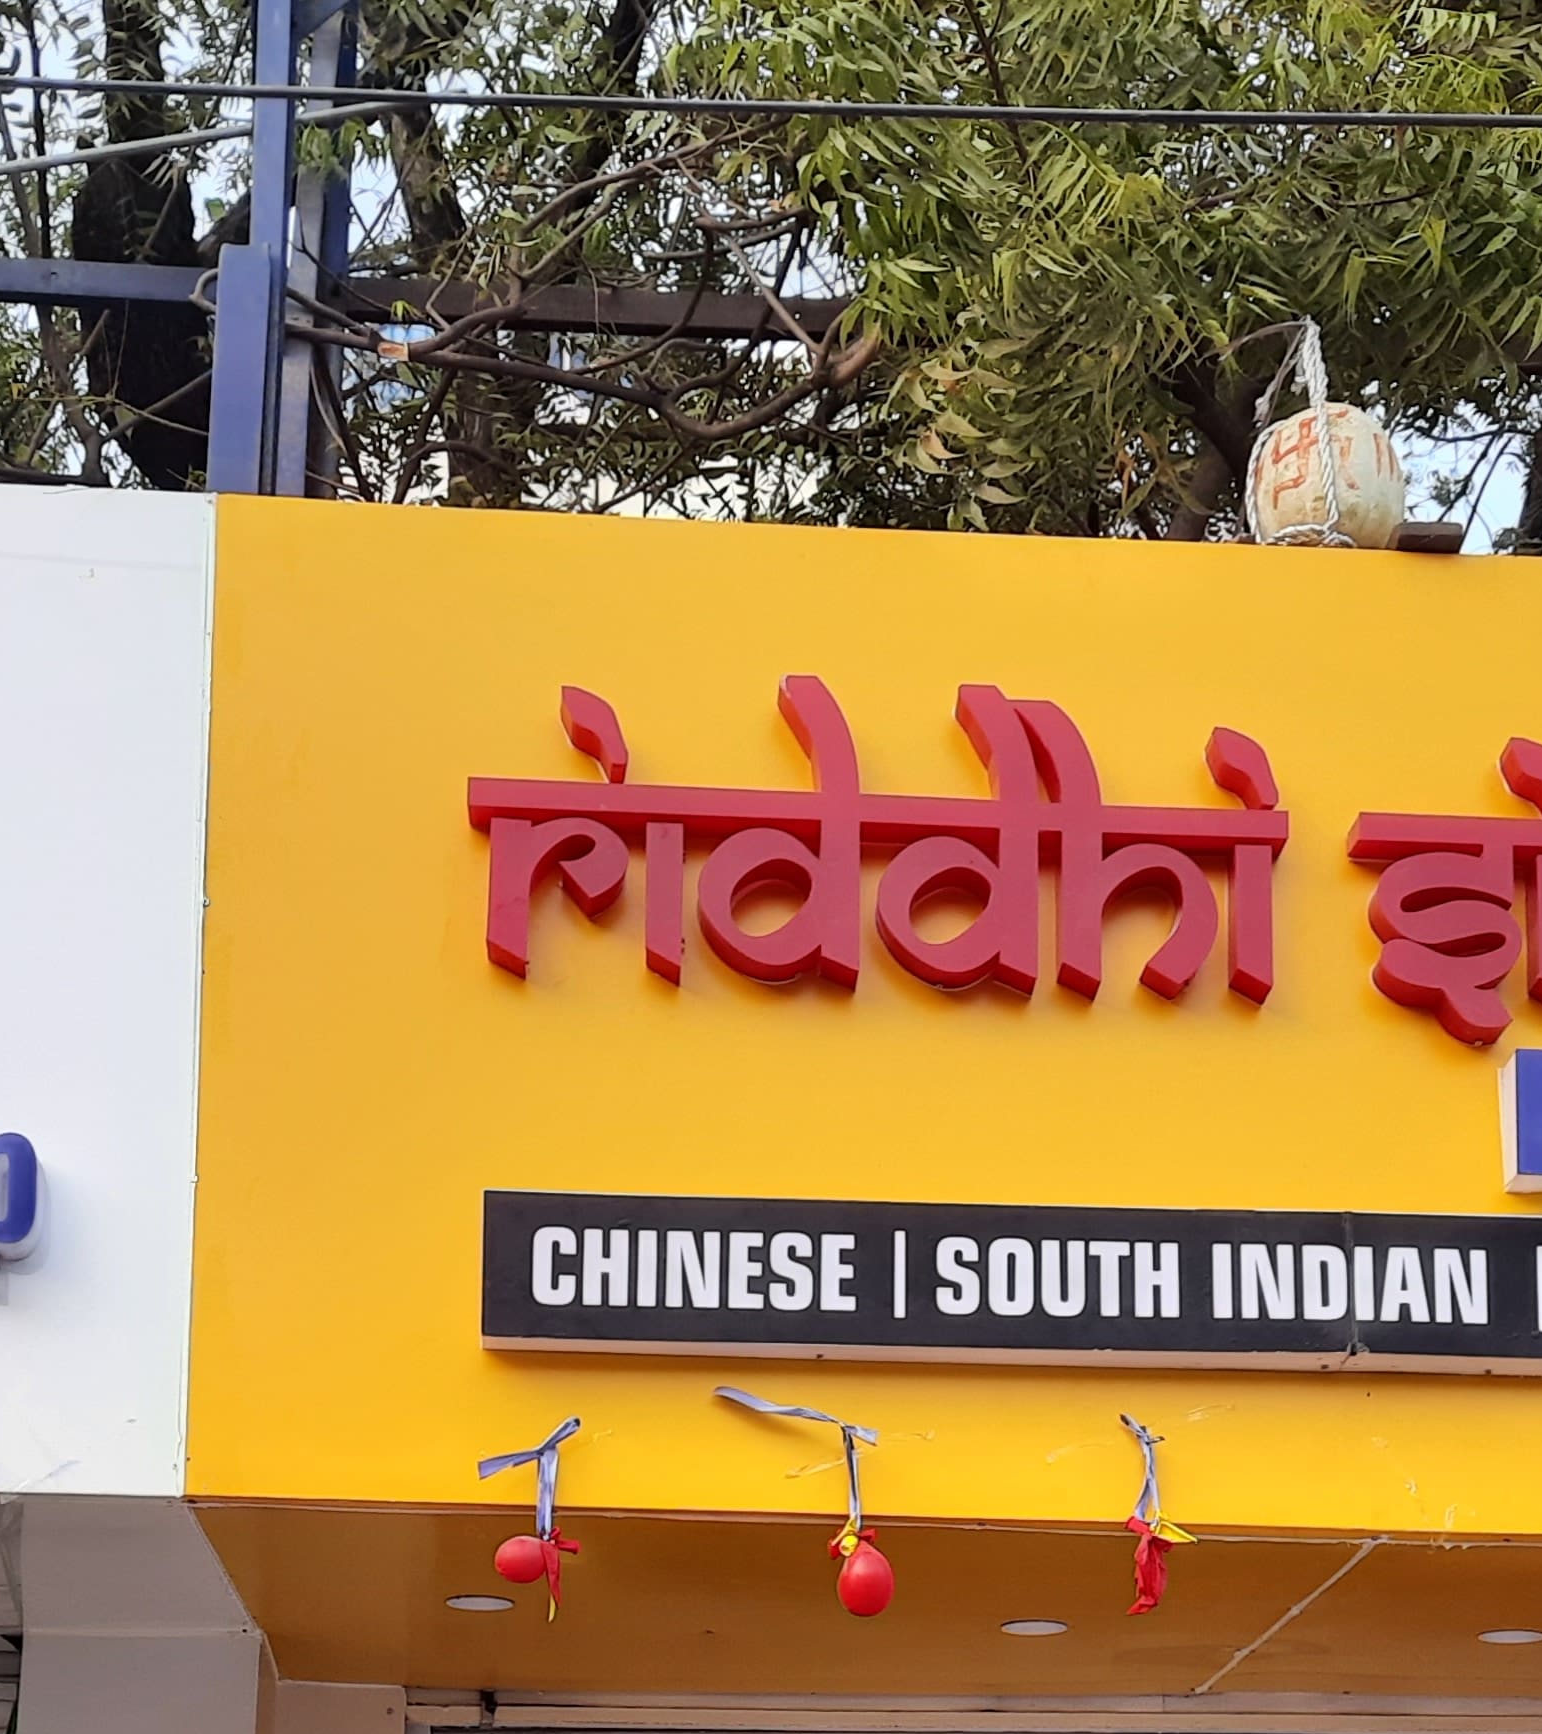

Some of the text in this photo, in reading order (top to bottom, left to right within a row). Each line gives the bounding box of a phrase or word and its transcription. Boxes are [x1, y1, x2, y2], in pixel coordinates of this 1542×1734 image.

[468, 674, 1289, 1004] riddhi
[531, 1225, 858, 1313] CHINESE
[935, 1237, 1489, 1326] SOUTH INDIAN
